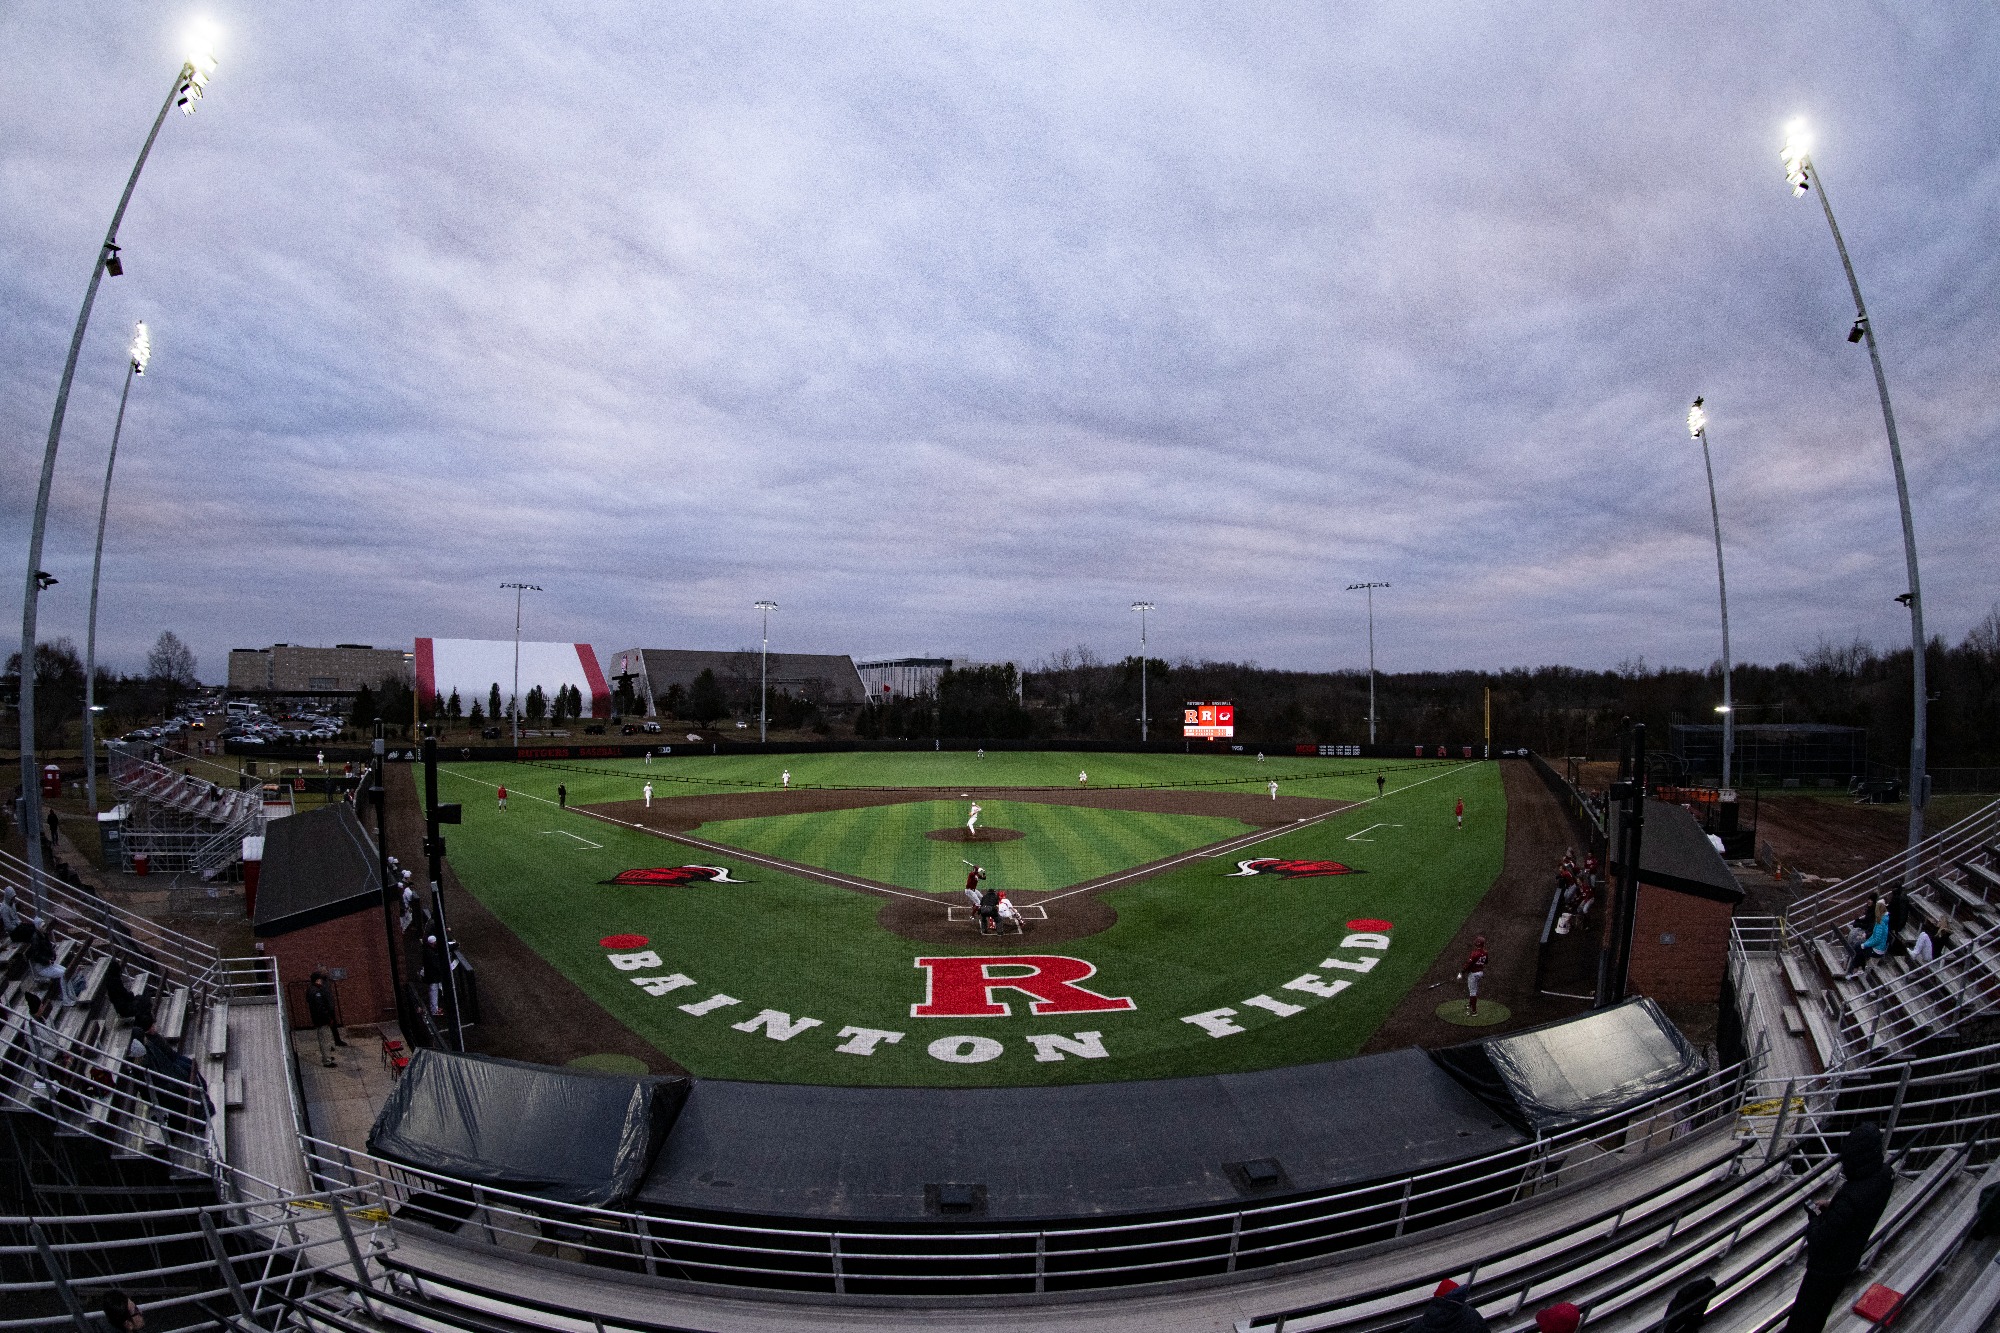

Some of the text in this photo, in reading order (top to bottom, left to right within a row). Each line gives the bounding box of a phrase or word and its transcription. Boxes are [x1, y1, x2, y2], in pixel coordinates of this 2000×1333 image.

[1201, 711, 1212, 721] R
[518, 746, 621, 758] RUTGERS BASEBALL
[606, 933, 1391, 1064] BAINTON FIELD
[909, 954, 1138, 1019] R
